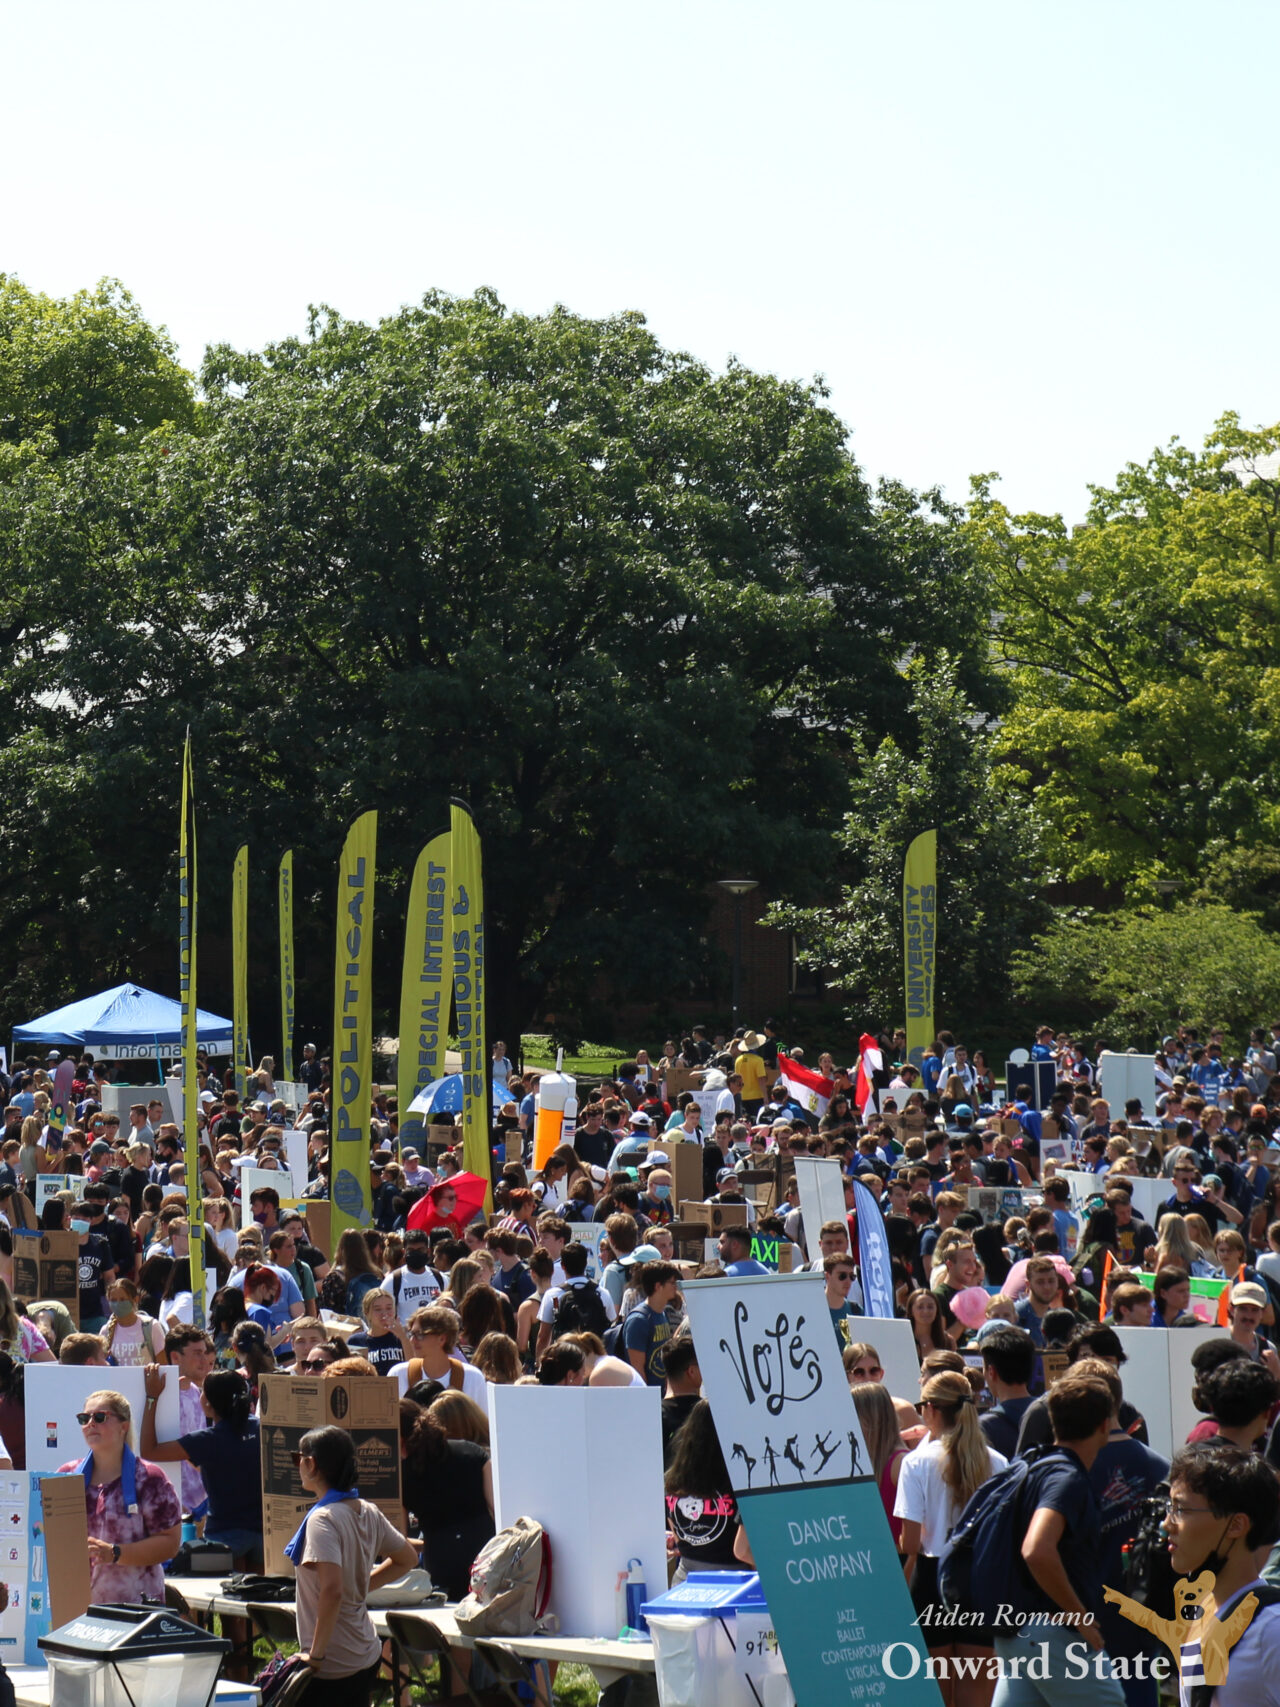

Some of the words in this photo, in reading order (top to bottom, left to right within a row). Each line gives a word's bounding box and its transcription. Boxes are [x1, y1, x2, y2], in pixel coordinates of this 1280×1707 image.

[421, 861, 446, 982] INTEREST
[906, 884, 925, 1018] UNIVERSITY
[336, 857, 366, 1141] POLITICAL
[403, 1286, 420, 1301] PENN
[787, 1515, 852, 1546] DANCE
[785, 1550, 873, 1585] COMPANY
[836, 1608, 858, 1625] JAZZ
[64, 1622, 98, 1641] TRASH
[93, 1627, 126, 1644] ONLY
[836, 1626, 866, 1643] BALLET
[845, 1664, 881, 1681] LYRICAL
[850, 1685, 866, 1700] HIP
[867, 1681, 887, 1696] HOP
